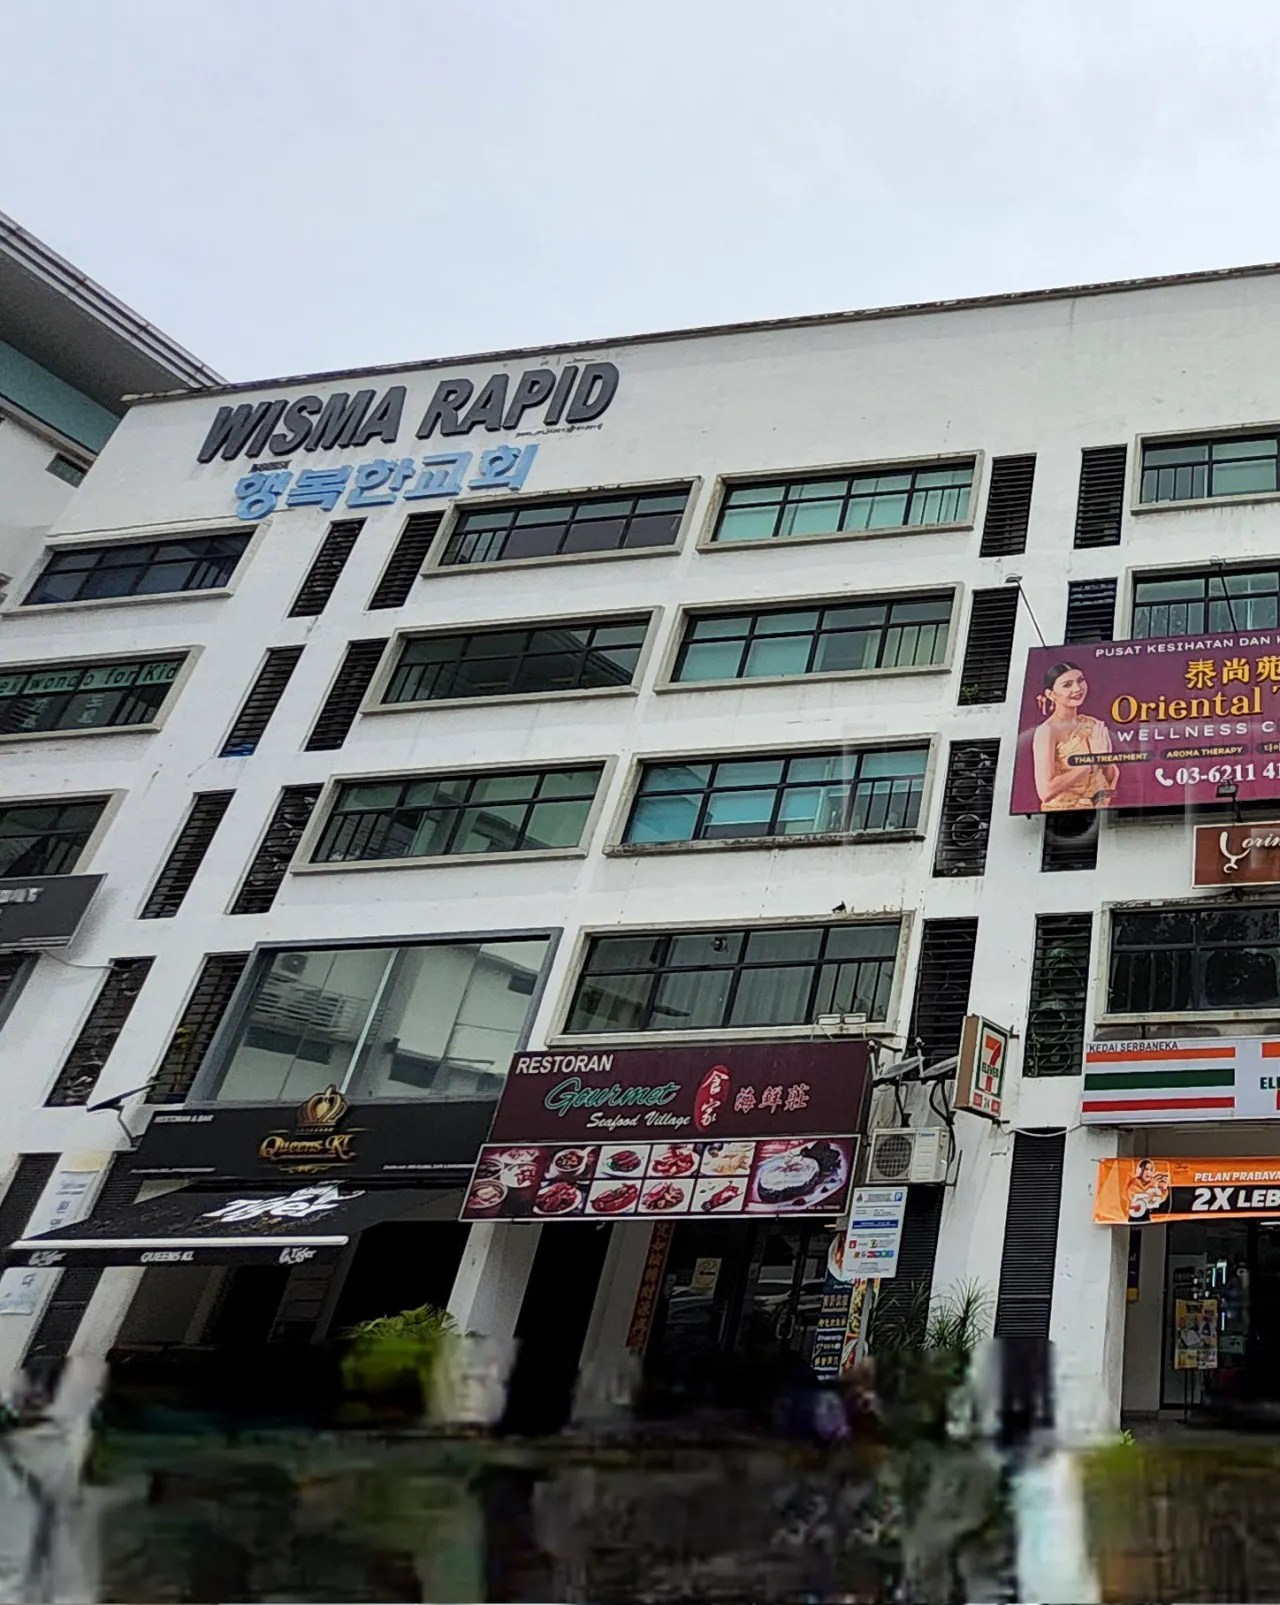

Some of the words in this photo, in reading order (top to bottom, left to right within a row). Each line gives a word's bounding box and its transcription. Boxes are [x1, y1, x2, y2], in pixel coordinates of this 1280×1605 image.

[196, 384, 408, 463] WISMA
[416, 360, 621, 440] RAPID
[233, 443, 540, 520] 행복한교회
[1095, 645, 1142, 658] PUSAT
[1147, 638, 1234, 654] KESIHATAN
[1239, 635, 1271, 647] DAN
[105, 669, 135, 686] for
[1110, 686, 1263, 724] Oriental
[1116, 721, 1249, 743] WELLNESS
[1073, 755, 1095, 764] THAI
[1096, 752, 1149, 763] TREATMENT
[1166, 749, 1200, 759] AROMA
[1201, 745, 1244, 757] THERAPY
[1175, 763, 1256, 785] 03-6211
[1089, 1043, 1119, 1053] KEDAI
[1121, 1041, 1178, 1051] SERBANEKA
[516, 1054, 614, 1075] RESTORAN
[984, 1034, 1002, 1094] 7
[545, 1078, 682, 1117] Gourmet
[587, 1111, 640, 1132] Seafood
[644, 1109, 692, 1127] Village
[1194, 1173, 1231, 1182] PELAN
[1128, 1187, 1164, 1218] 5G
[1191, 1187, 1235, 1211] 2X
[140, 1252, 180, 1262] QUEENS
